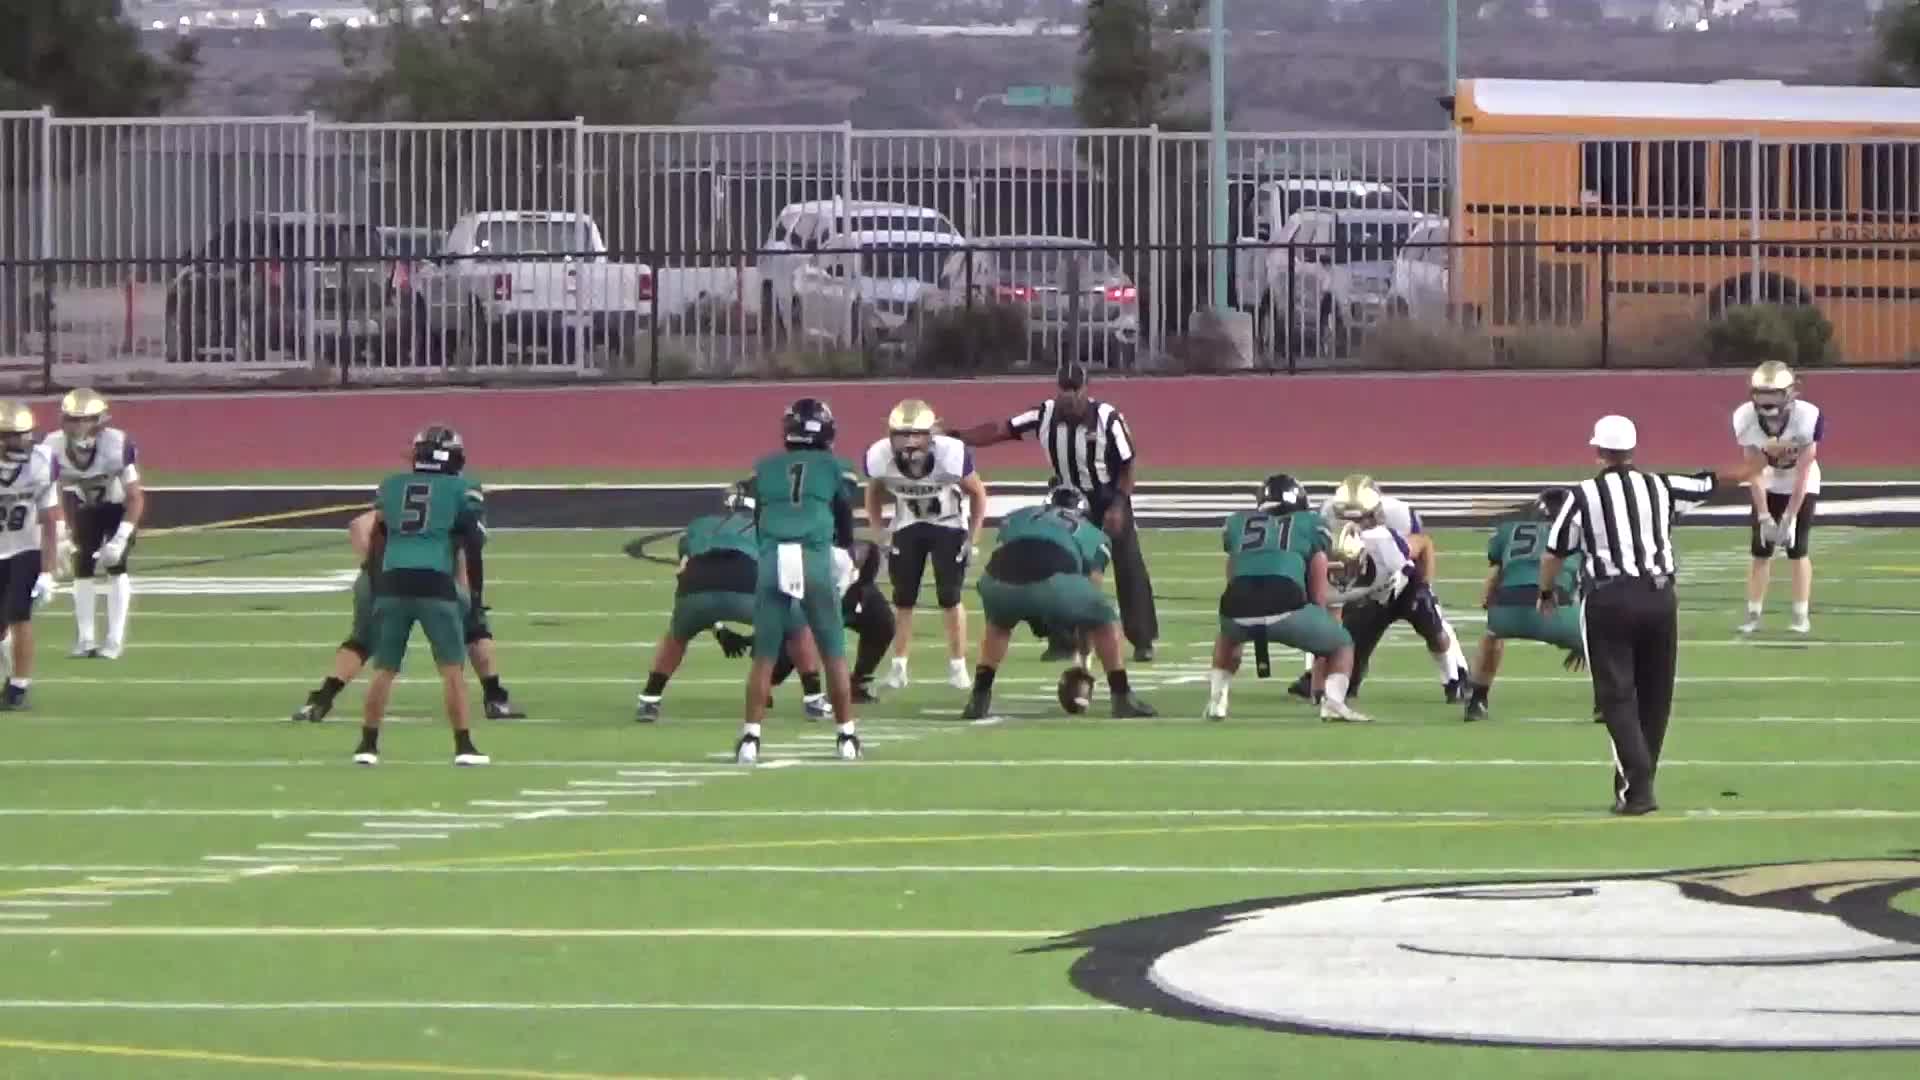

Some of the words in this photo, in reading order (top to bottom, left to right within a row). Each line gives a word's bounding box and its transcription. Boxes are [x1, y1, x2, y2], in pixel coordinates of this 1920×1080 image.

[787, 461, 808, 507] 1
[400, 483, 431, 534] 5
[1239, 515, 1295, 552] 51
[1508, 522, 1551, 560] 5
